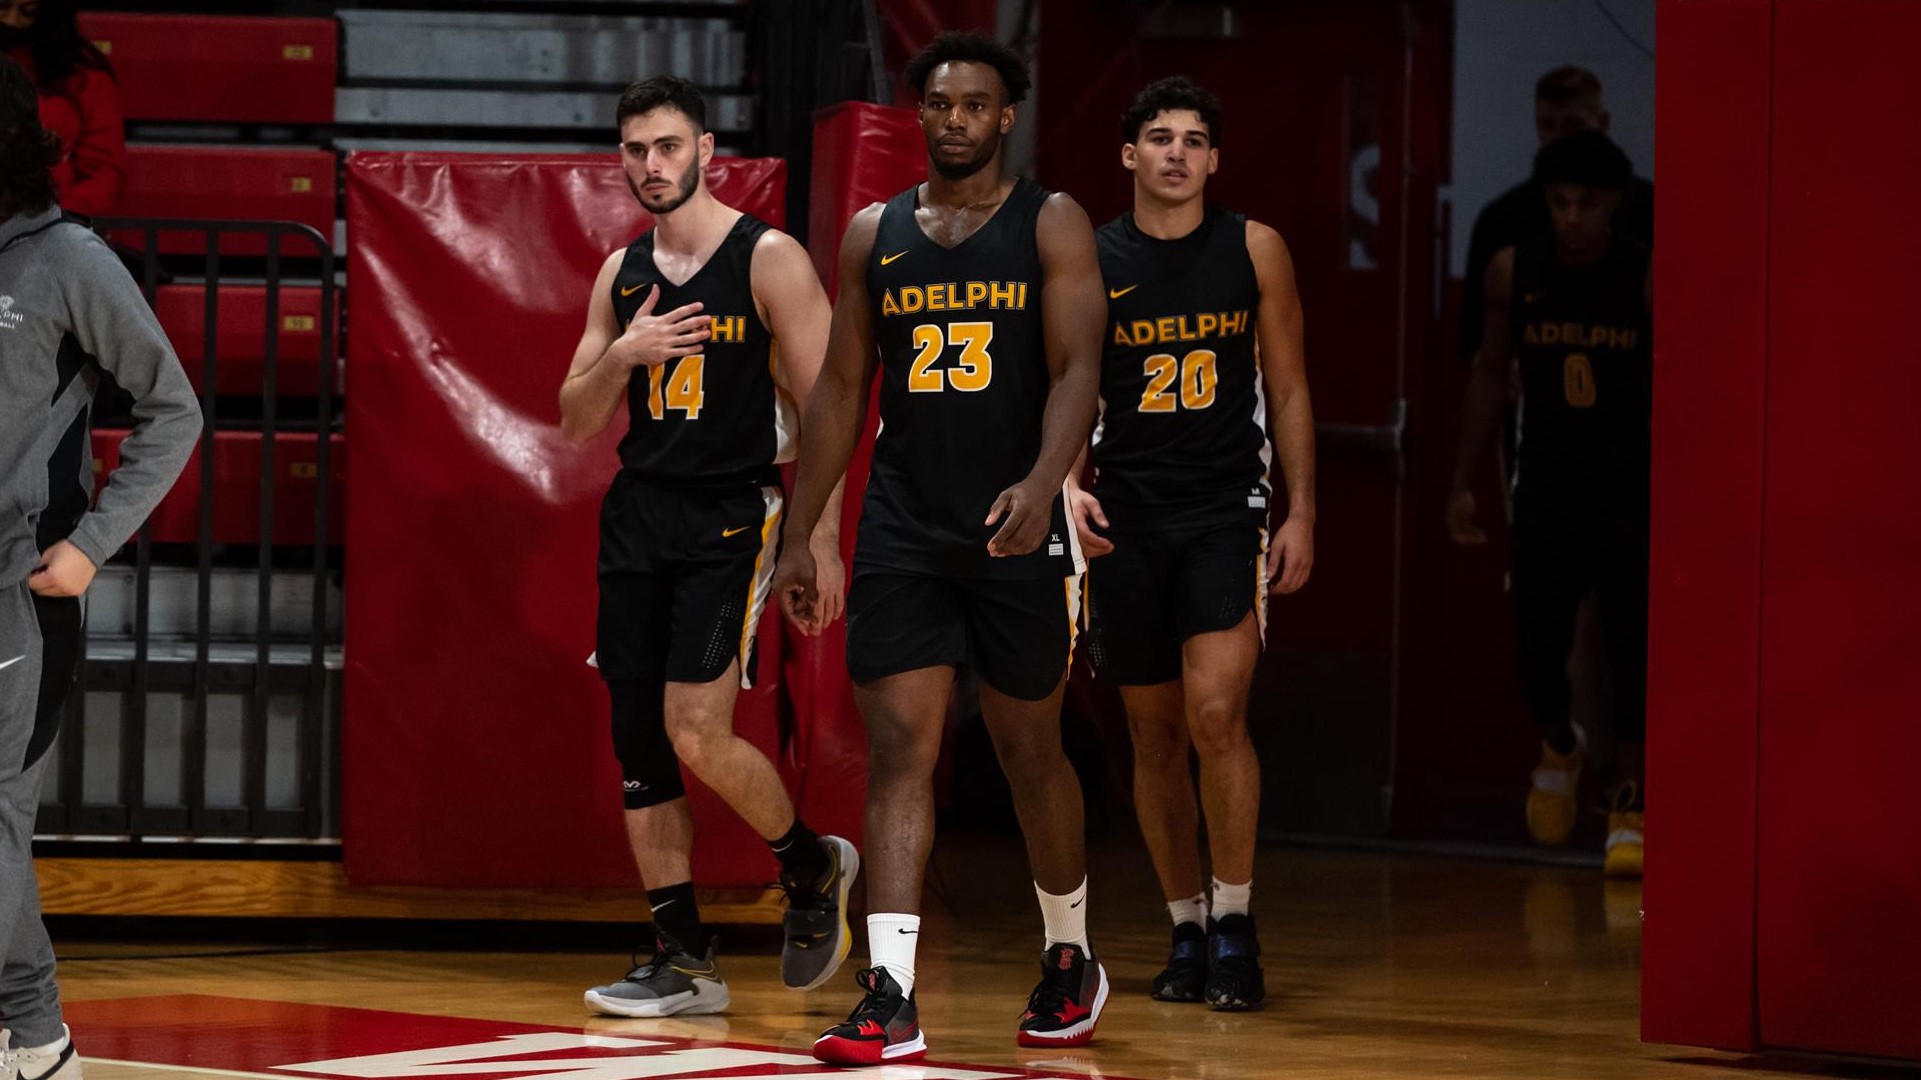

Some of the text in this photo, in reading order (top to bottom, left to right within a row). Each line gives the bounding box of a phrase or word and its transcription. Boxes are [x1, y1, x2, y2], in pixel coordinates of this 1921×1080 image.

[881, 281, 1028, 317] ADELPHI
[1113, 310, 1249, 347] ADELPHI
[1522, 321, 1638, 350] ADELPHI
[908, 321, 994, 393] 23
[1563, 352, 1598, 409] 0
[647, 354, 705, 420] 14
[1137, 349, 1218, 413] 20
[1051, 533, 1060, 542] XL
